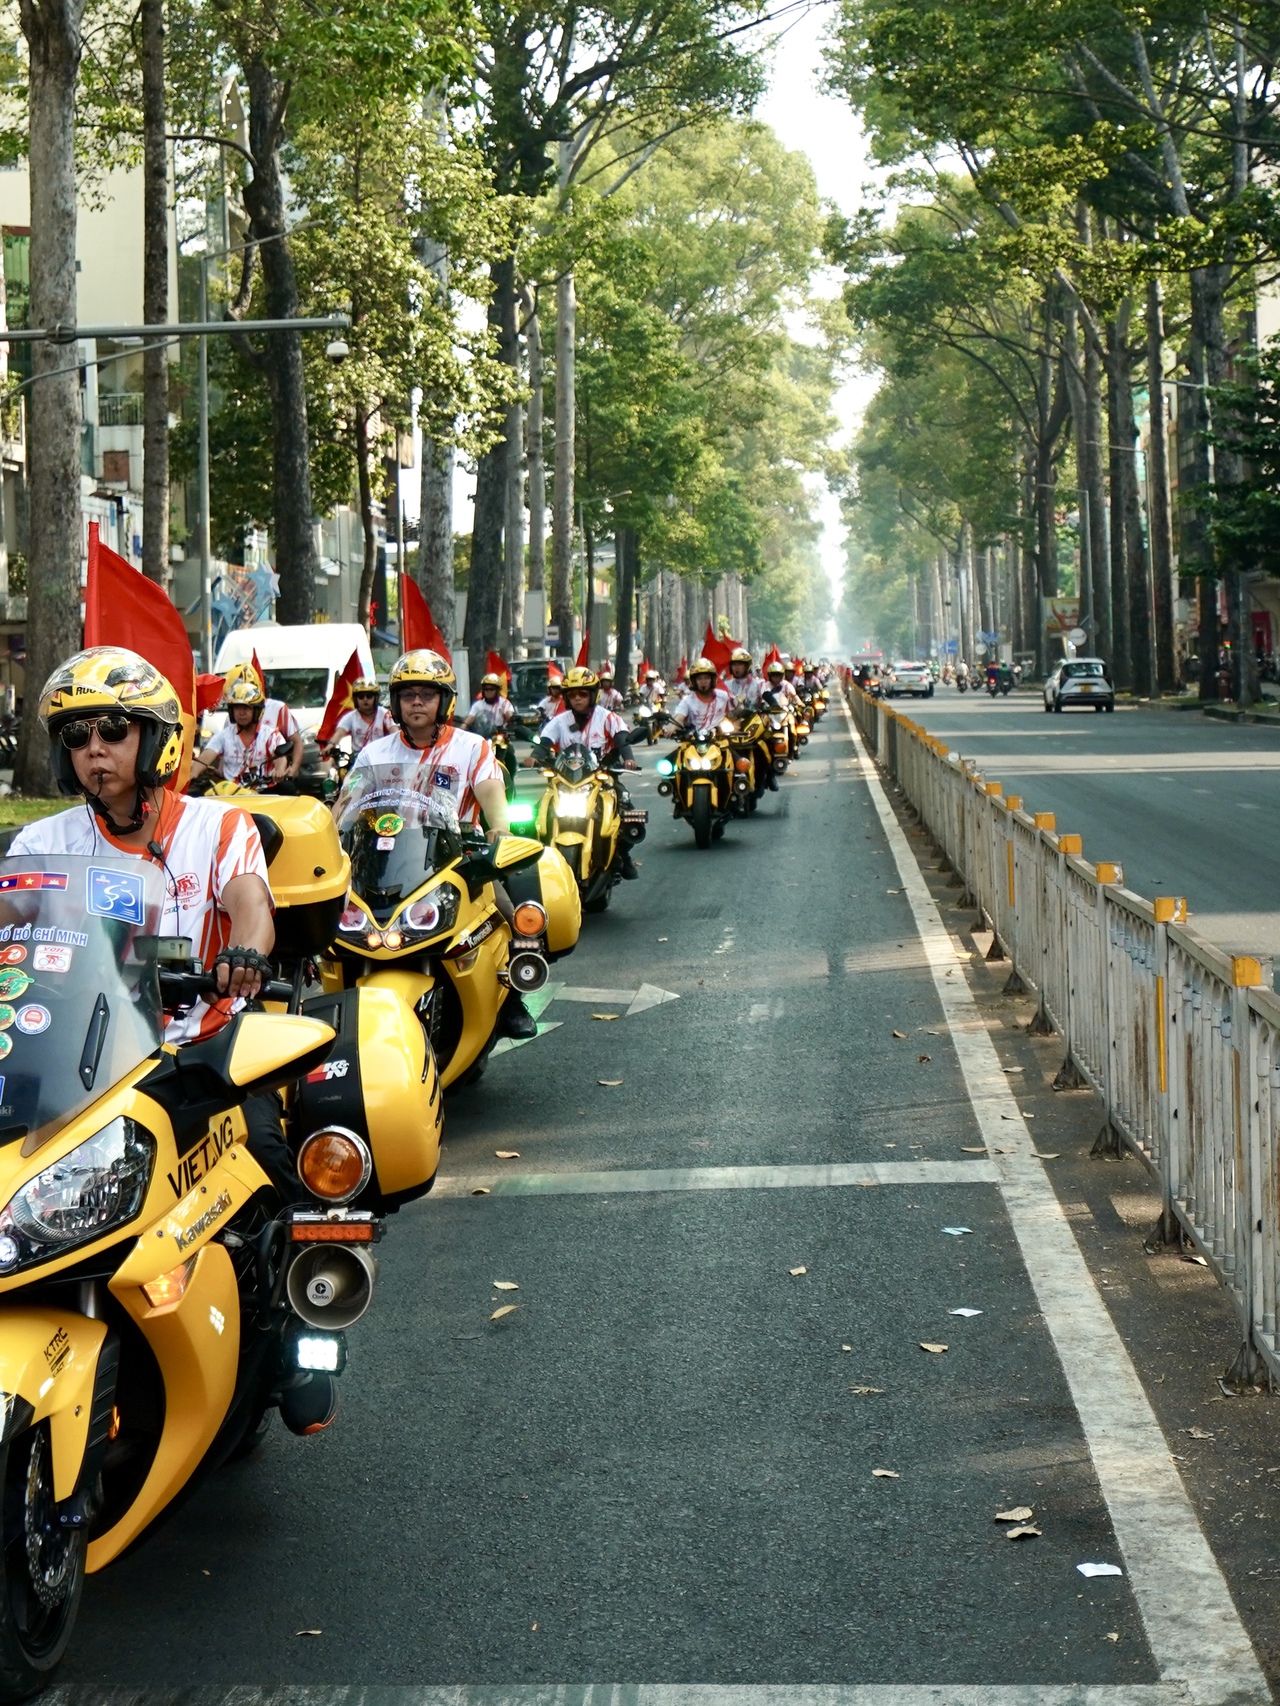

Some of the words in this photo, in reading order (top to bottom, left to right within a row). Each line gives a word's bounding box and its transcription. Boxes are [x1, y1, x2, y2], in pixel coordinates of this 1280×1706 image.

[13, 923, 32, 941] HỒ
[33, 926, 57, 941] CHÍ
[56, 930, 88, 947] MINH
[323, 1059, 349, 1080] K&N
[173, 1188, 233, 1253] Kawasaki
[43, 1326, 68, 1361] KTRC
